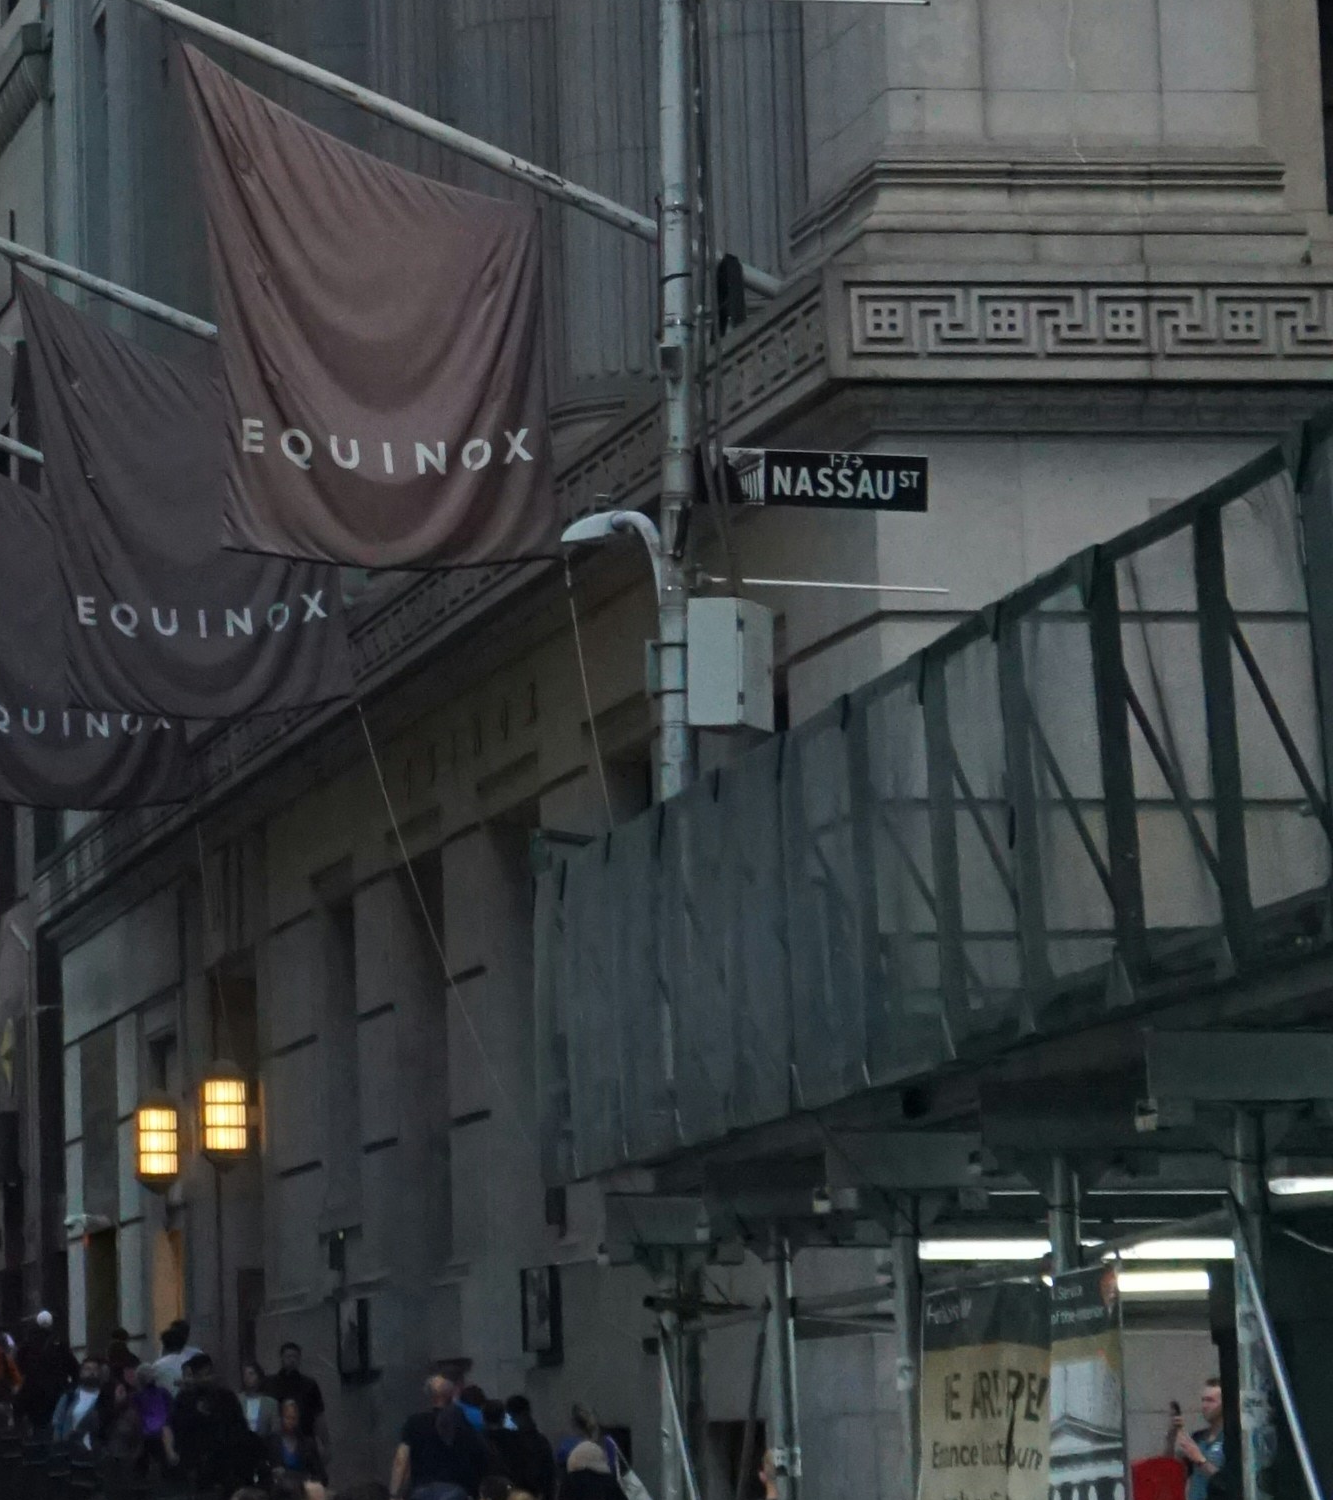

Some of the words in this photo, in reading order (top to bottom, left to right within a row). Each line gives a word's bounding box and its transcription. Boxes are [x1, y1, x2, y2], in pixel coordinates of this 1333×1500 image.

[242, 418, 533, 475] EQUINOX
[773, 466, 895, 500] NASSAU
[899, 471, 920, 488] ST
[77, 591, 327, 638] EQUINOX
